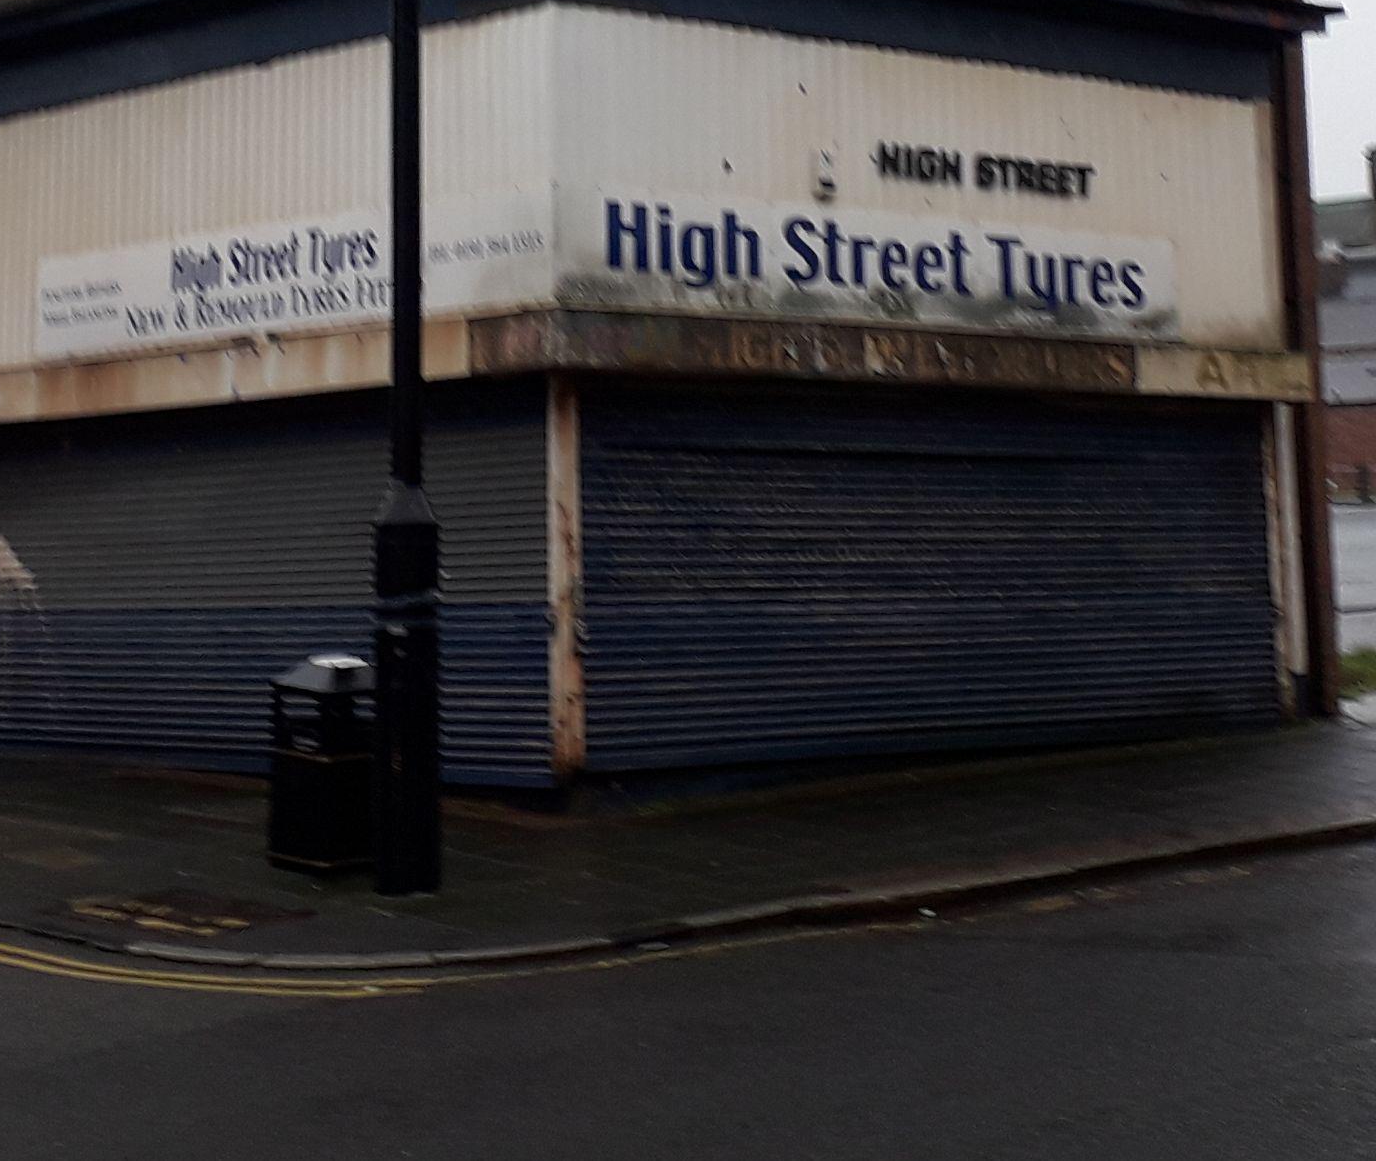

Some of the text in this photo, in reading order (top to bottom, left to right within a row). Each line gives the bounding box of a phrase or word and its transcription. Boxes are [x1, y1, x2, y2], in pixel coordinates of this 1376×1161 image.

[878, 140, 1096, 198] HIGH STREET
[170, 240, 222, 296] High
[226, 230, 301, 286] Street
[307, 227, 380, 284] Tyres
[604, 200, 1143, 314] High Street Tyres
[174, 294, 191, 331] &
